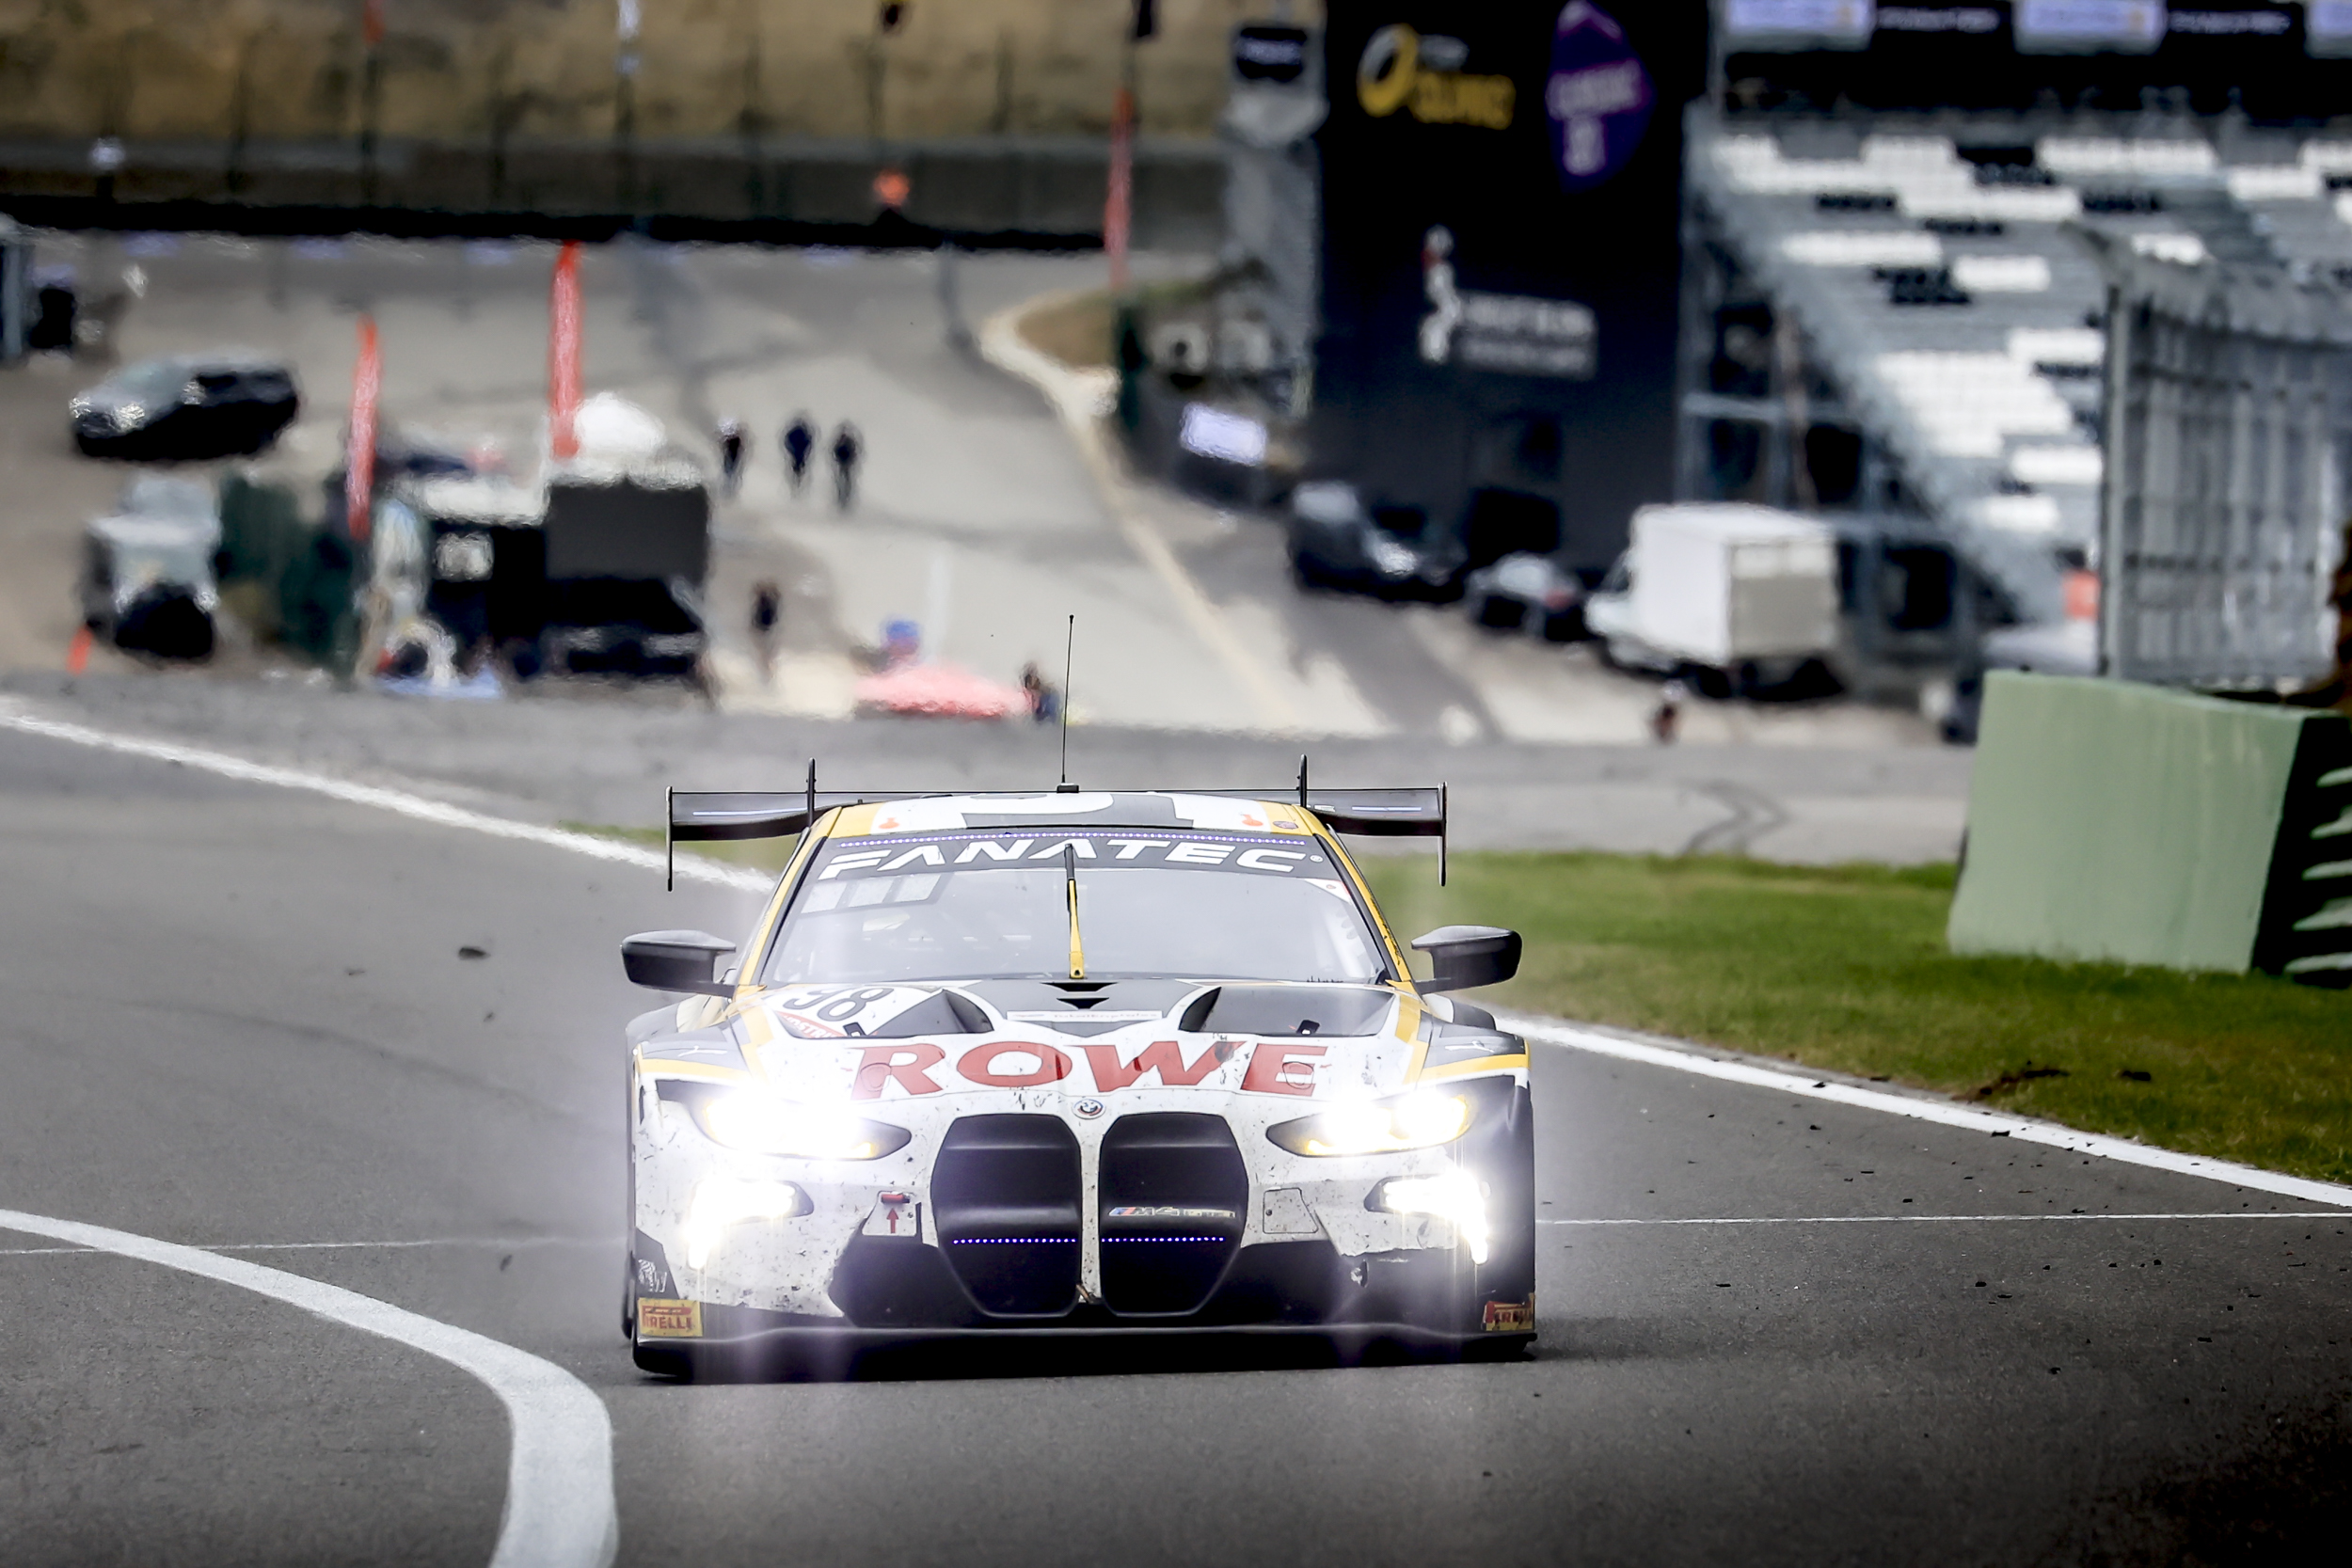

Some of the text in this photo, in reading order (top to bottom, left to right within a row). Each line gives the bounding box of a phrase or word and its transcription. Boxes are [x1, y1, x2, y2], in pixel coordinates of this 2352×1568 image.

[818, 838, 1307, 879] FANATEC
[845, 1040, 1327, 1099] ROWE
[642, 1305, 692, 1329] PIRELLI
